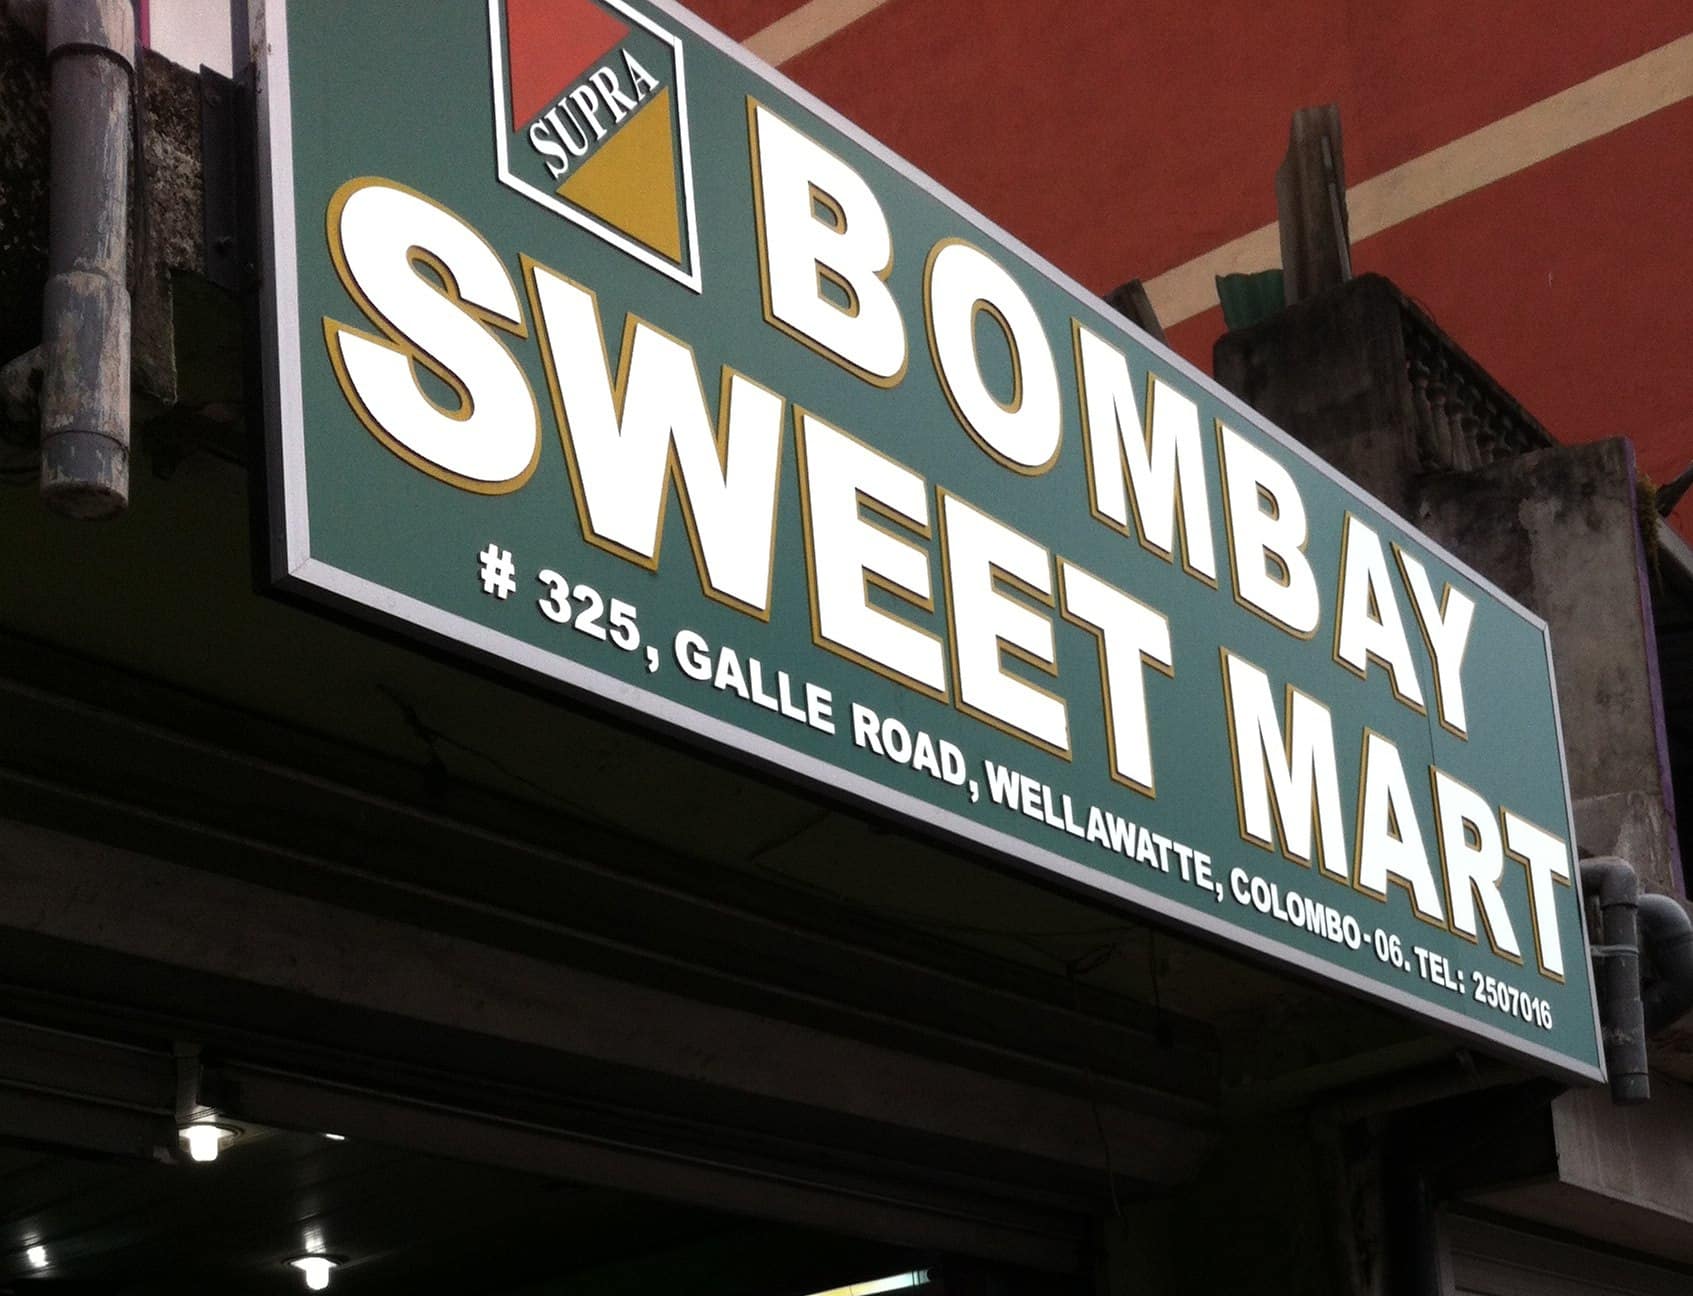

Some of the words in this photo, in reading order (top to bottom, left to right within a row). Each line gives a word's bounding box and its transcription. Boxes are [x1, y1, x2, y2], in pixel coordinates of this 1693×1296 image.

[528, 47, 660, 180] SUPRA
[323, 176, 1175, 798] SWEET
[1220, 646, 1571, 984] MART
[746, 95, 1476, 741] BOMBAY
[478, 543, 516, 601] #
[537, 568, 660, 673] 325,
[674, 629, 836, 735] GALLE
[851, 702, 980, 803] ROAD,
[984, 760, 1224, 902] WELLAWATTE,
[1413, 947, 1466, 994] TEL:
[1472, 971, 1553, 1030] 2507016
